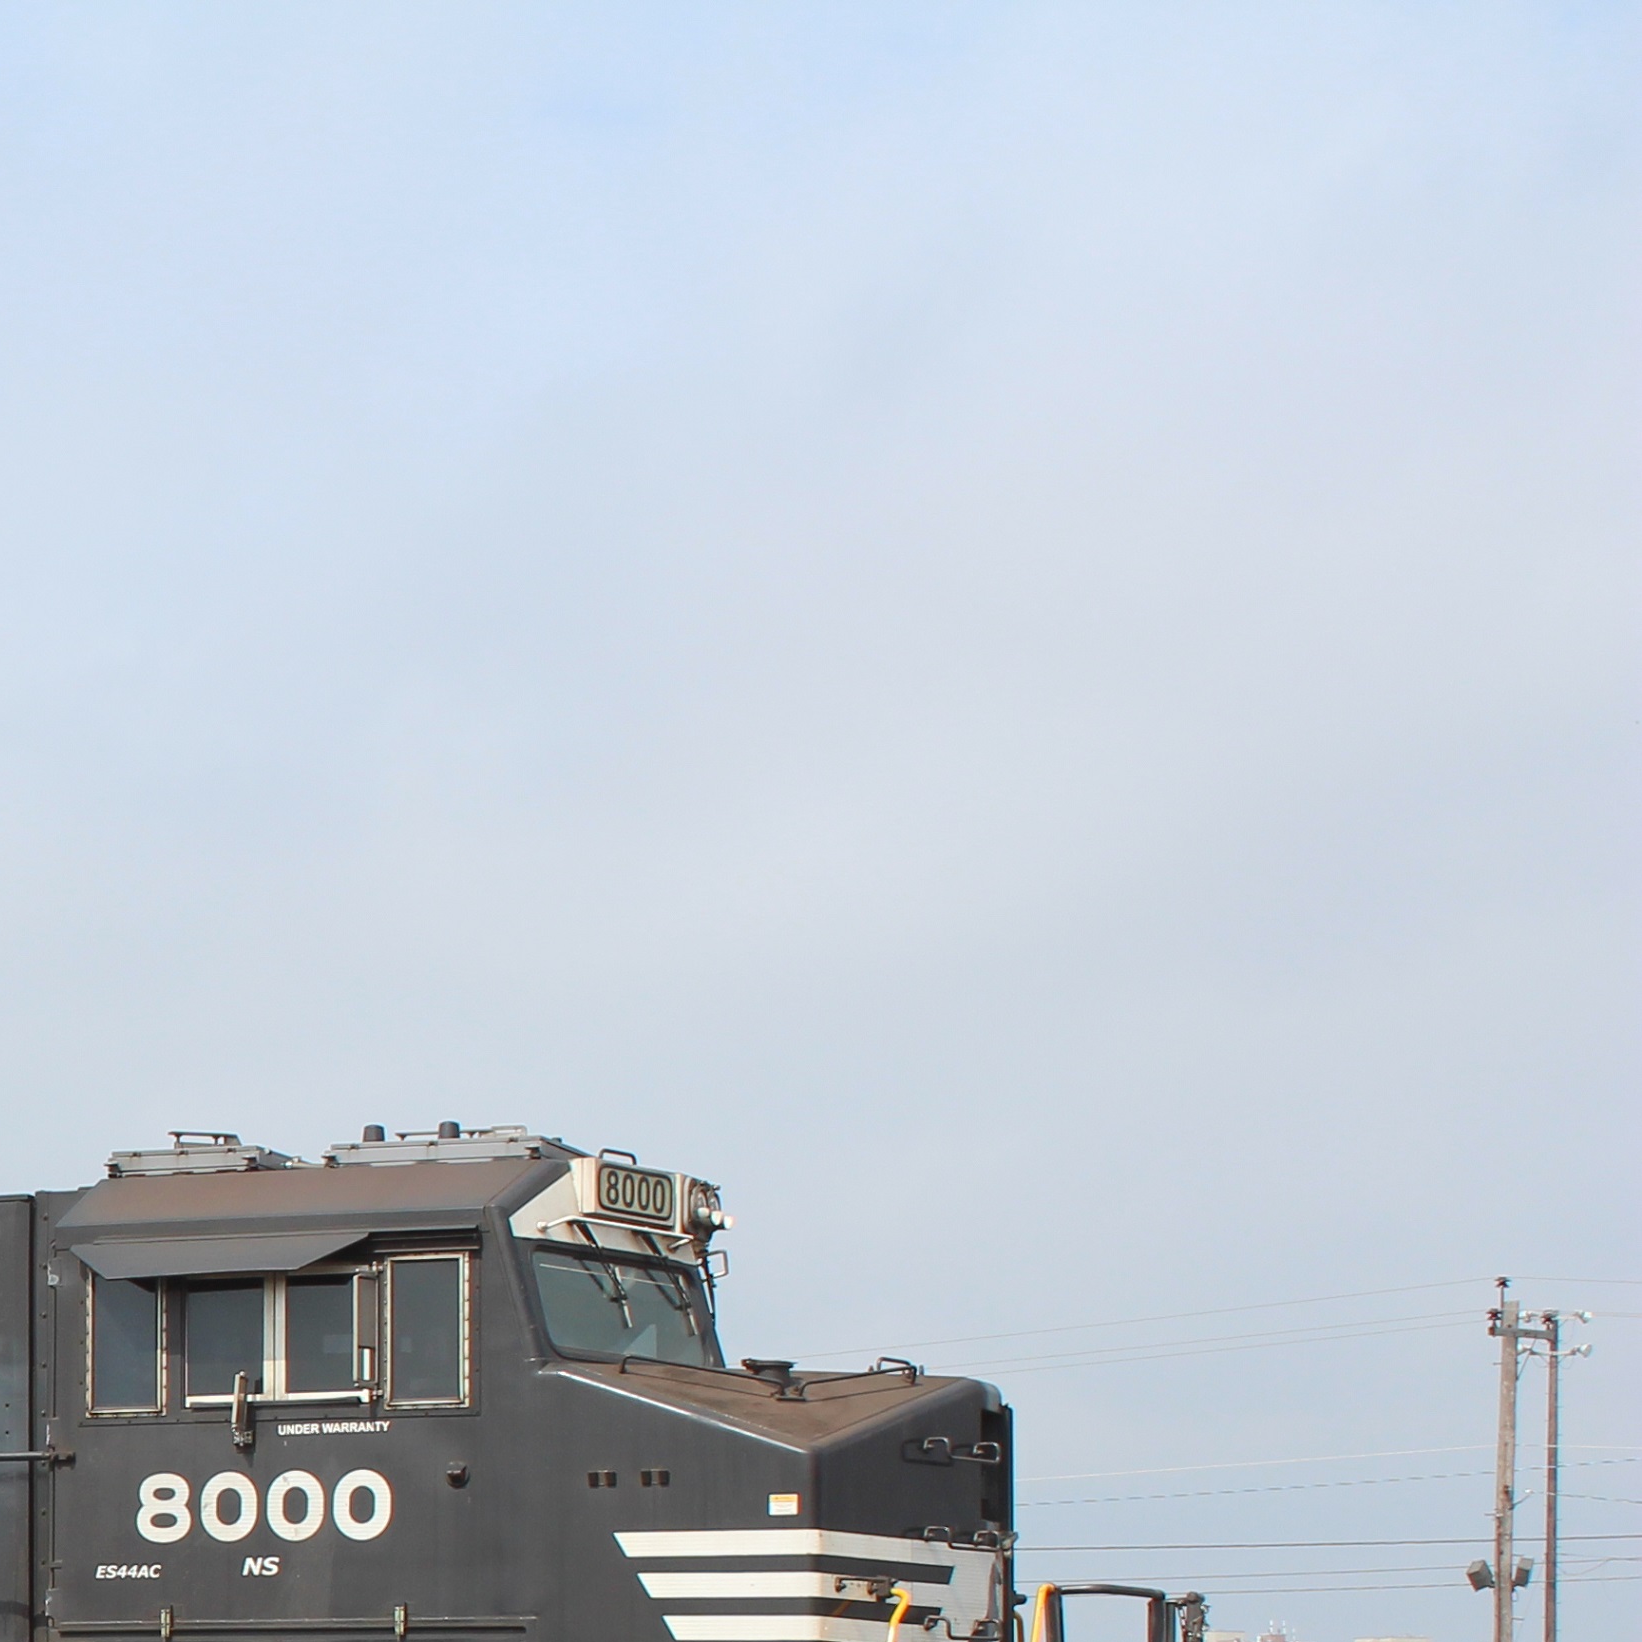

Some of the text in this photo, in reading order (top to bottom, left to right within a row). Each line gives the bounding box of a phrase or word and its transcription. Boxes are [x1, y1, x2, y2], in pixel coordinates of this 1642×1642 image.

[606, 1170, 666, 1214] 8000
[277, 1421, 391, 1436] UNDER WARRANTY
[135, 1467, 394, 1544] 8000
[94, 1564, 163, 1580] ES44AC
[241, 1555, 281, 1577] NS
